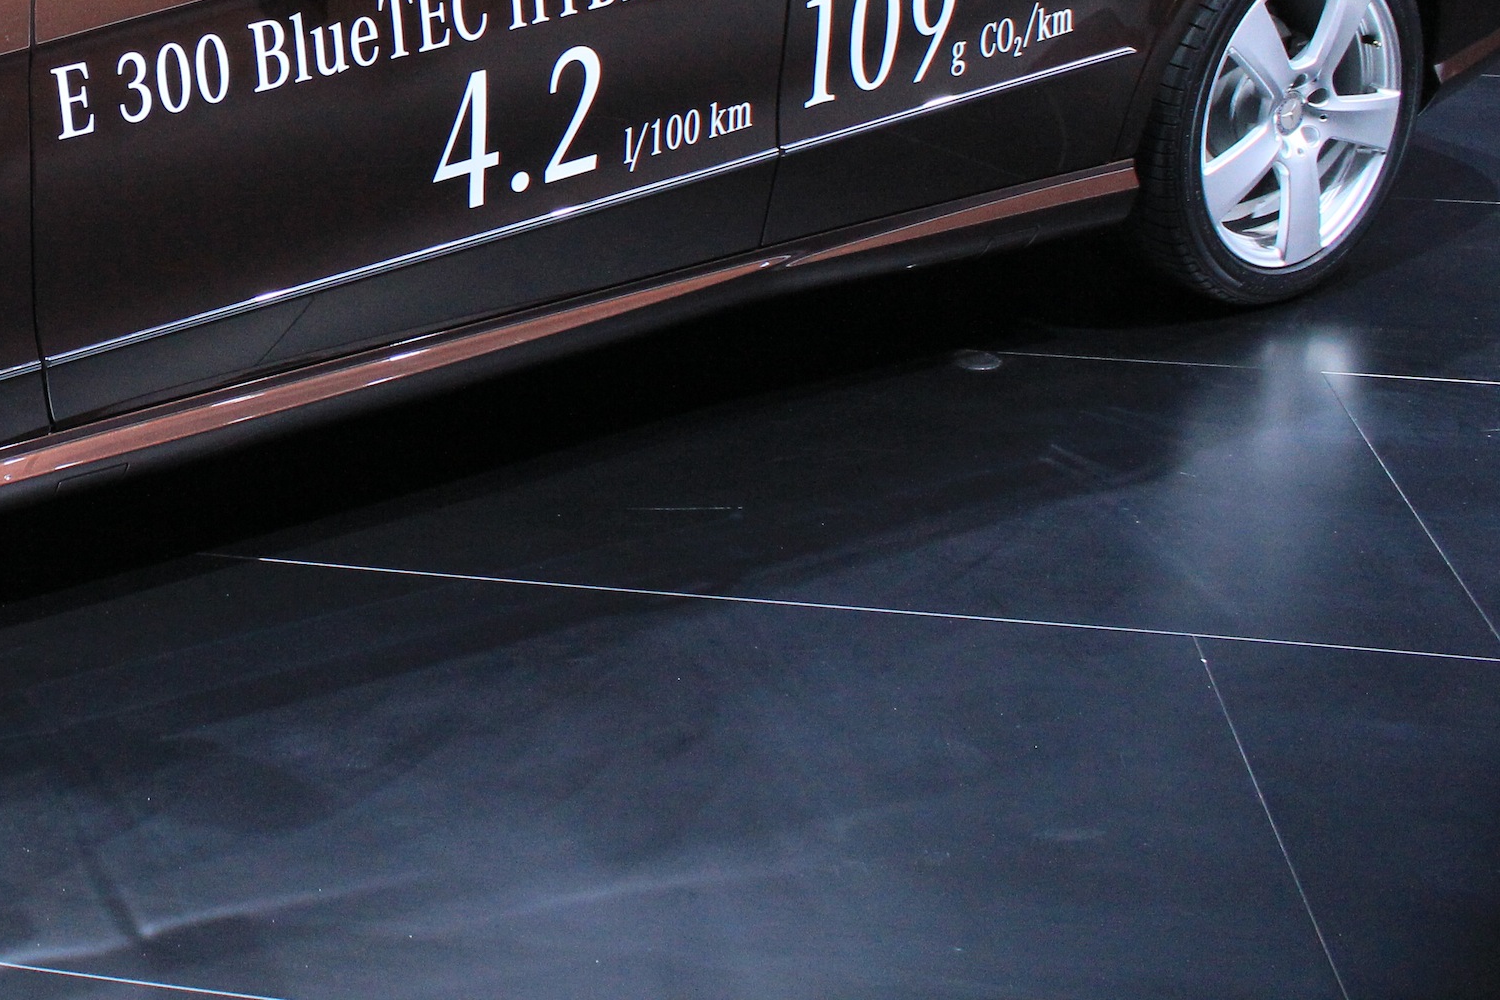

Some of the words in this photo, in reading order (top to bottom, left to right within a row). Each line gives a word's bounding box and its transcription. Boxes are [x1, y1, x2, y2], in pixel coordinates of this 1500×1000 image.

[50, 61, 95, 140] E
[117, 33, 230, 124] 300
[950, 40, 966, 77] g
[432, 45, 601, 209] 4.2
[708, 101, 753, 139] km
